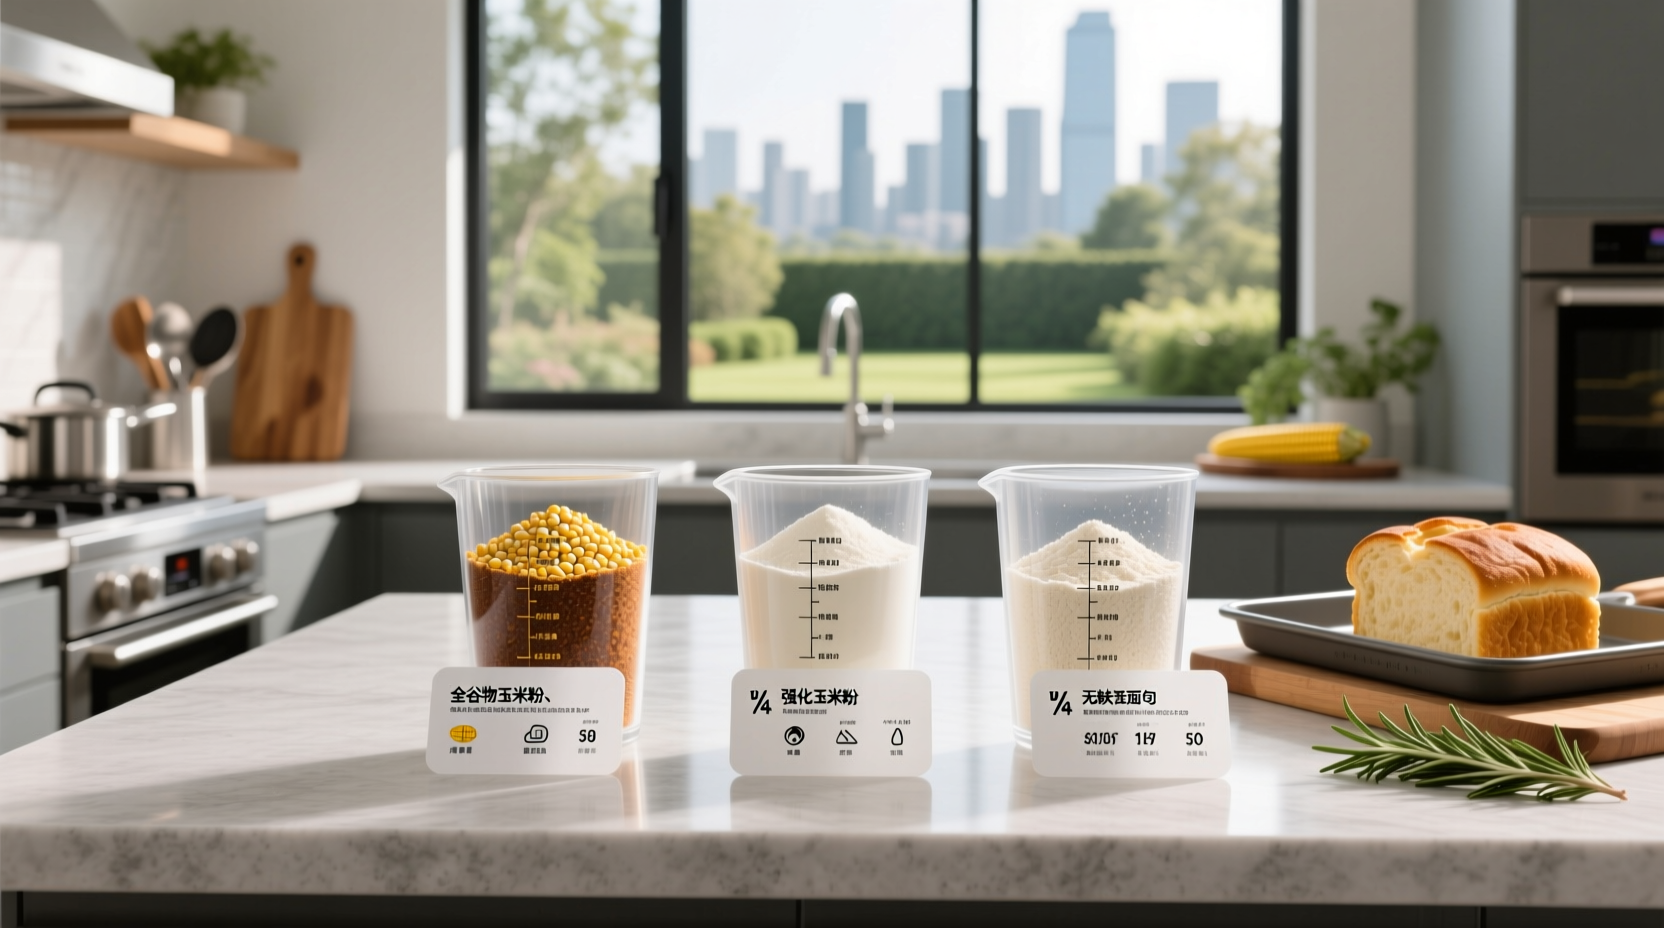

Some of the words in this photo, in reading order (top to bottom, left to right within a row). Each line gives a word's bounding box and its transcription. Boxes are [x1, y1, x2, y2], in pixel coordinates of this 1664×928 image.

[781, 688, 858, 706] 强化玉米粉
[1186, 732, 1203, 746] 50
